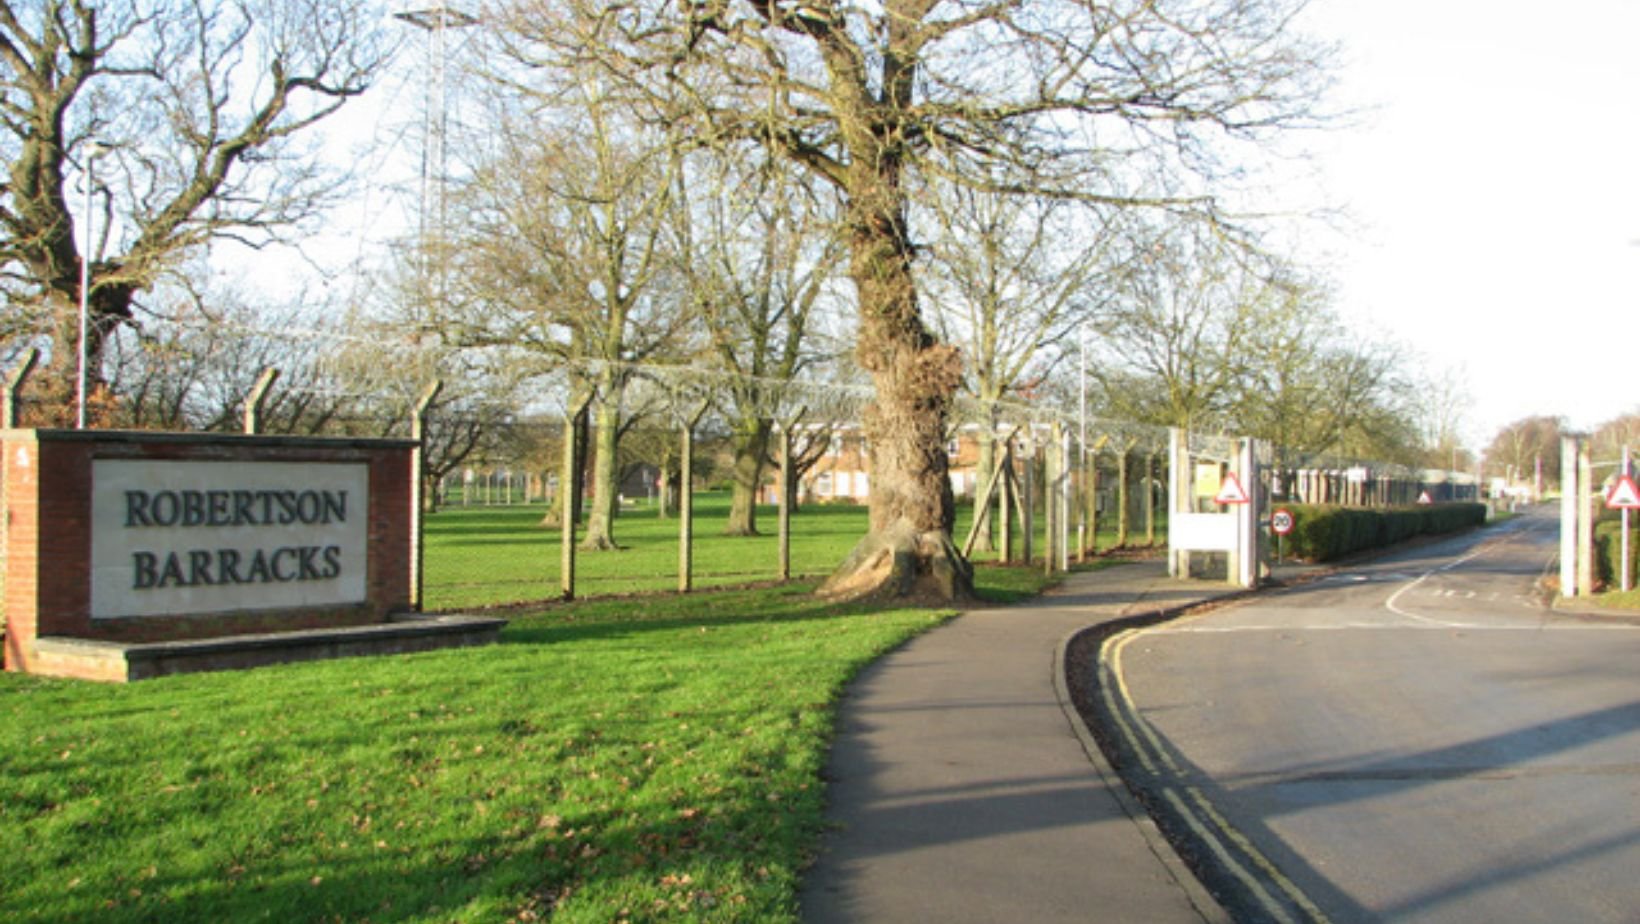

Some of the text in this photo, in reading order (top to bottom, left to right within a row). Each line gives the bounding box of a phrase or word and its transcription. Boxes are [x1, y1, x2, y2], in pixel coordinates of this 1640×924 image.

[124, 489, 348, 527] ROBERTSON
[1274, 515, 1290, 528] 20
[132, 546, 341, 588] BARRACKS
